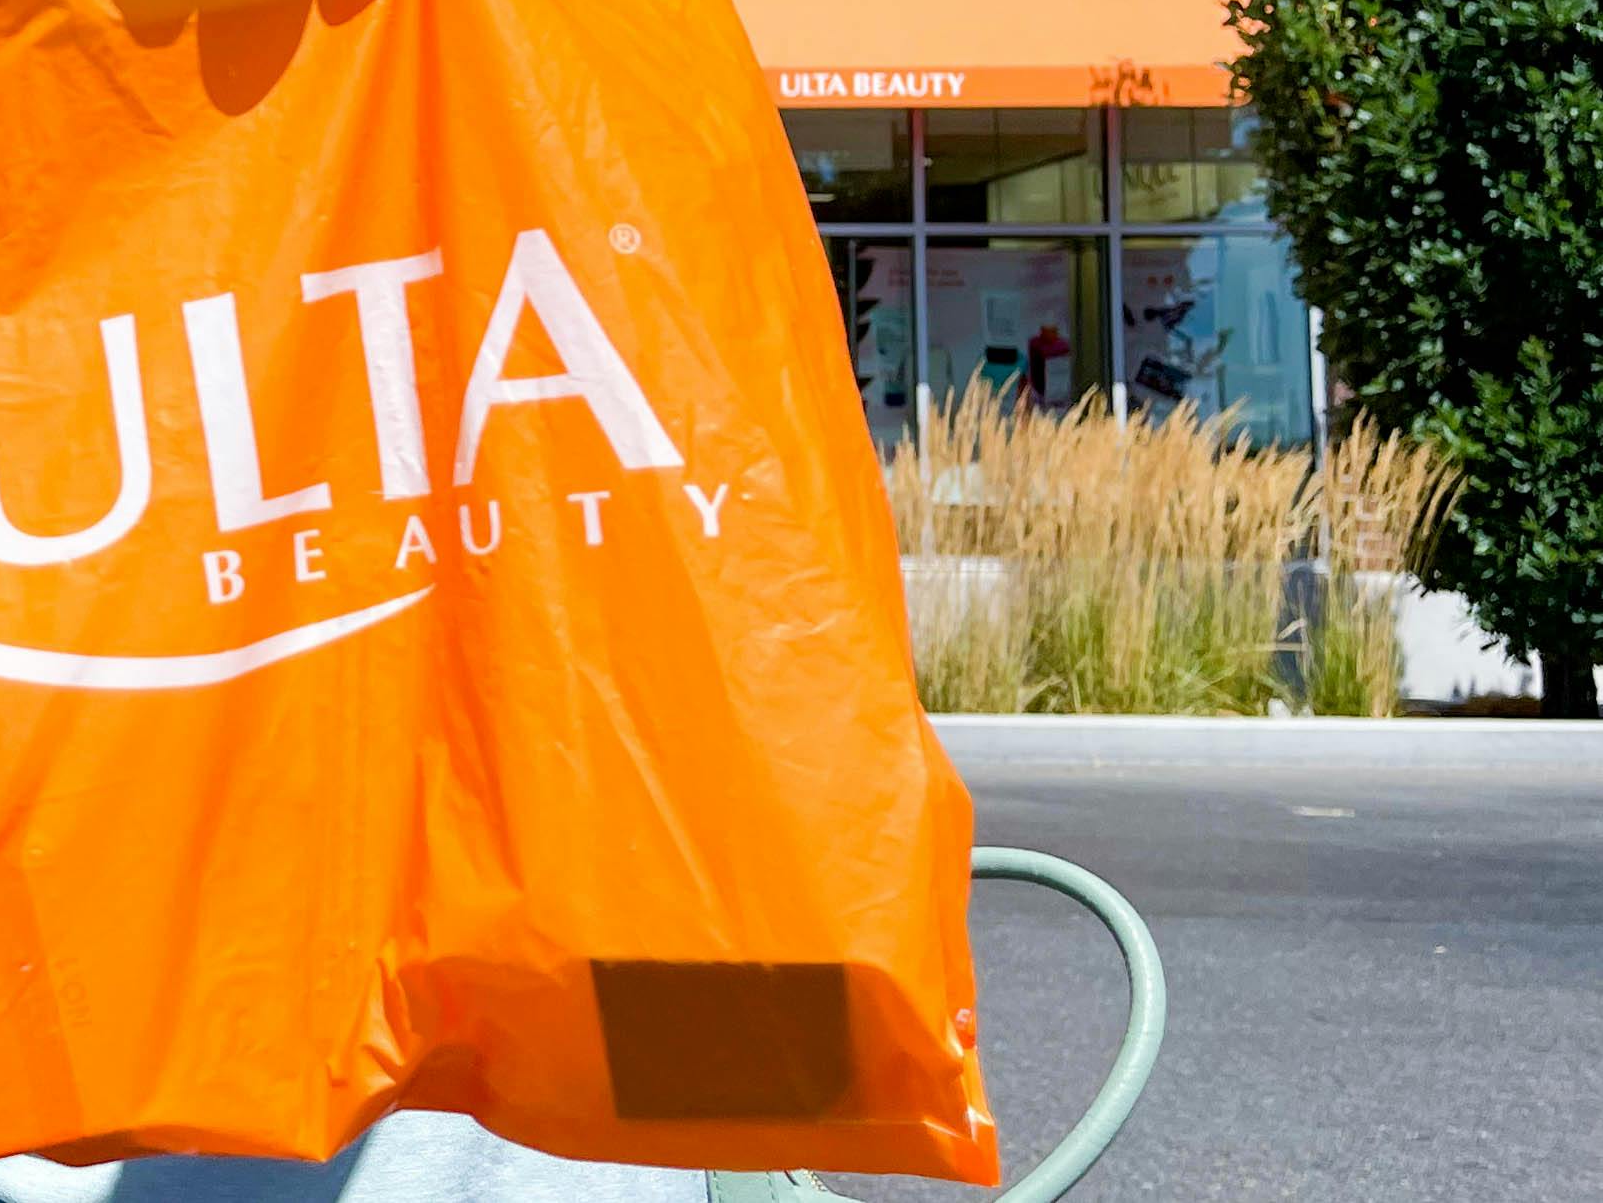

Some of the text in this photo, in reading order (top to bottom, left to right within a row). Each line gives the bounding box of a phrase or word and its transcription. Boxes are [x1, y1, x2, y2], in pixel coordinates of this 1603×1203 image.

[780, 72, 966, 97] ULTA BEAUTY
[202, 483, 729, 604] BEAUTY
